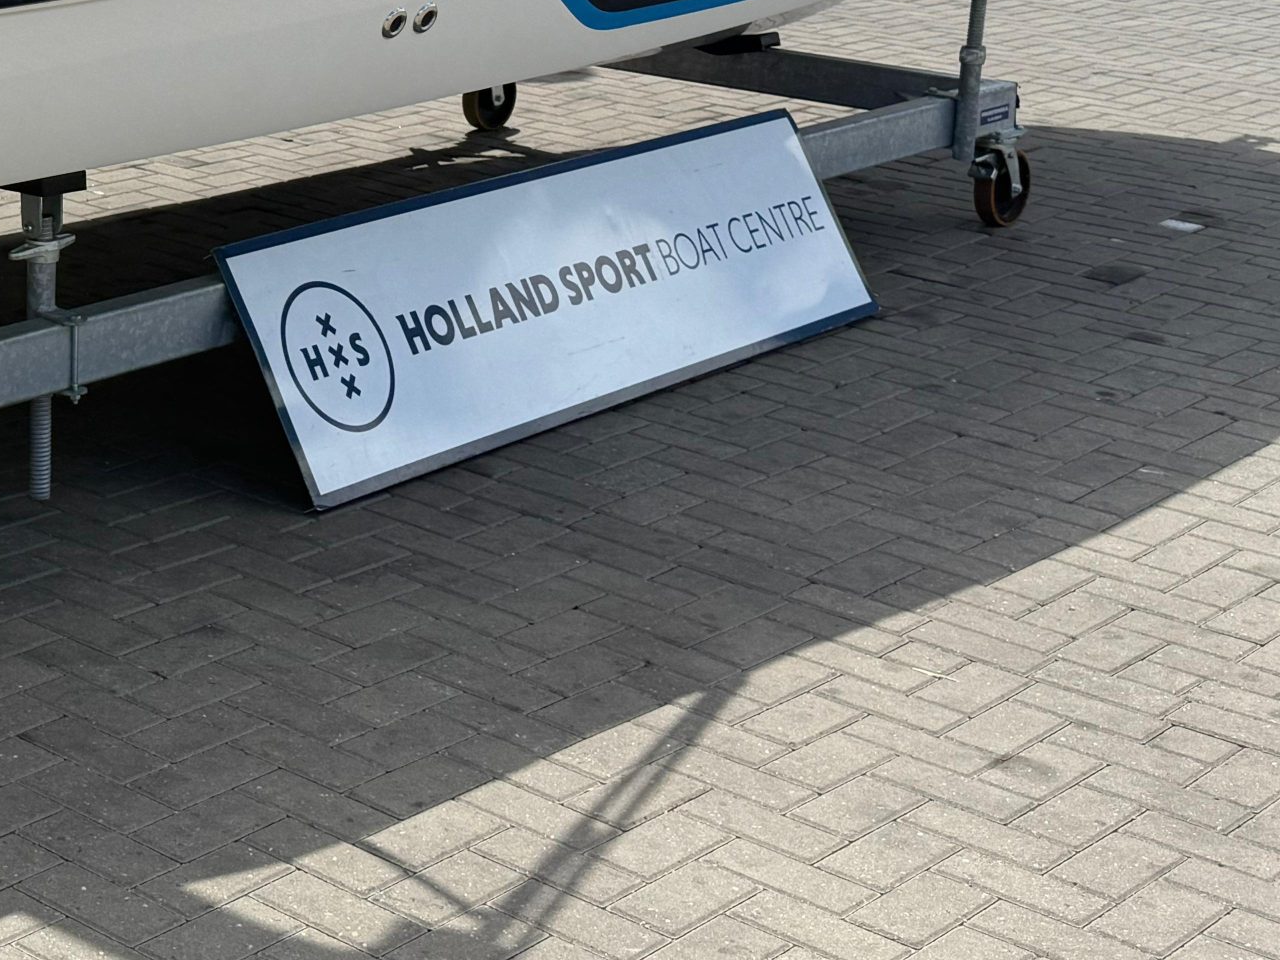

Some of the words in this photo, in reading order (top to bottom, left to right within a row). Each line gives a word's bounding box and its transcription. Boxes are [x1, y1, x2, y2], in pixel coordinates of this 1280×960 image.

[395, 274, 559, 355] HOLLAND
[559, 243, 657, 306] SPORT
[655, 222, 728, 276] BOAT
[727, 196, 825, 253] CENTRE
